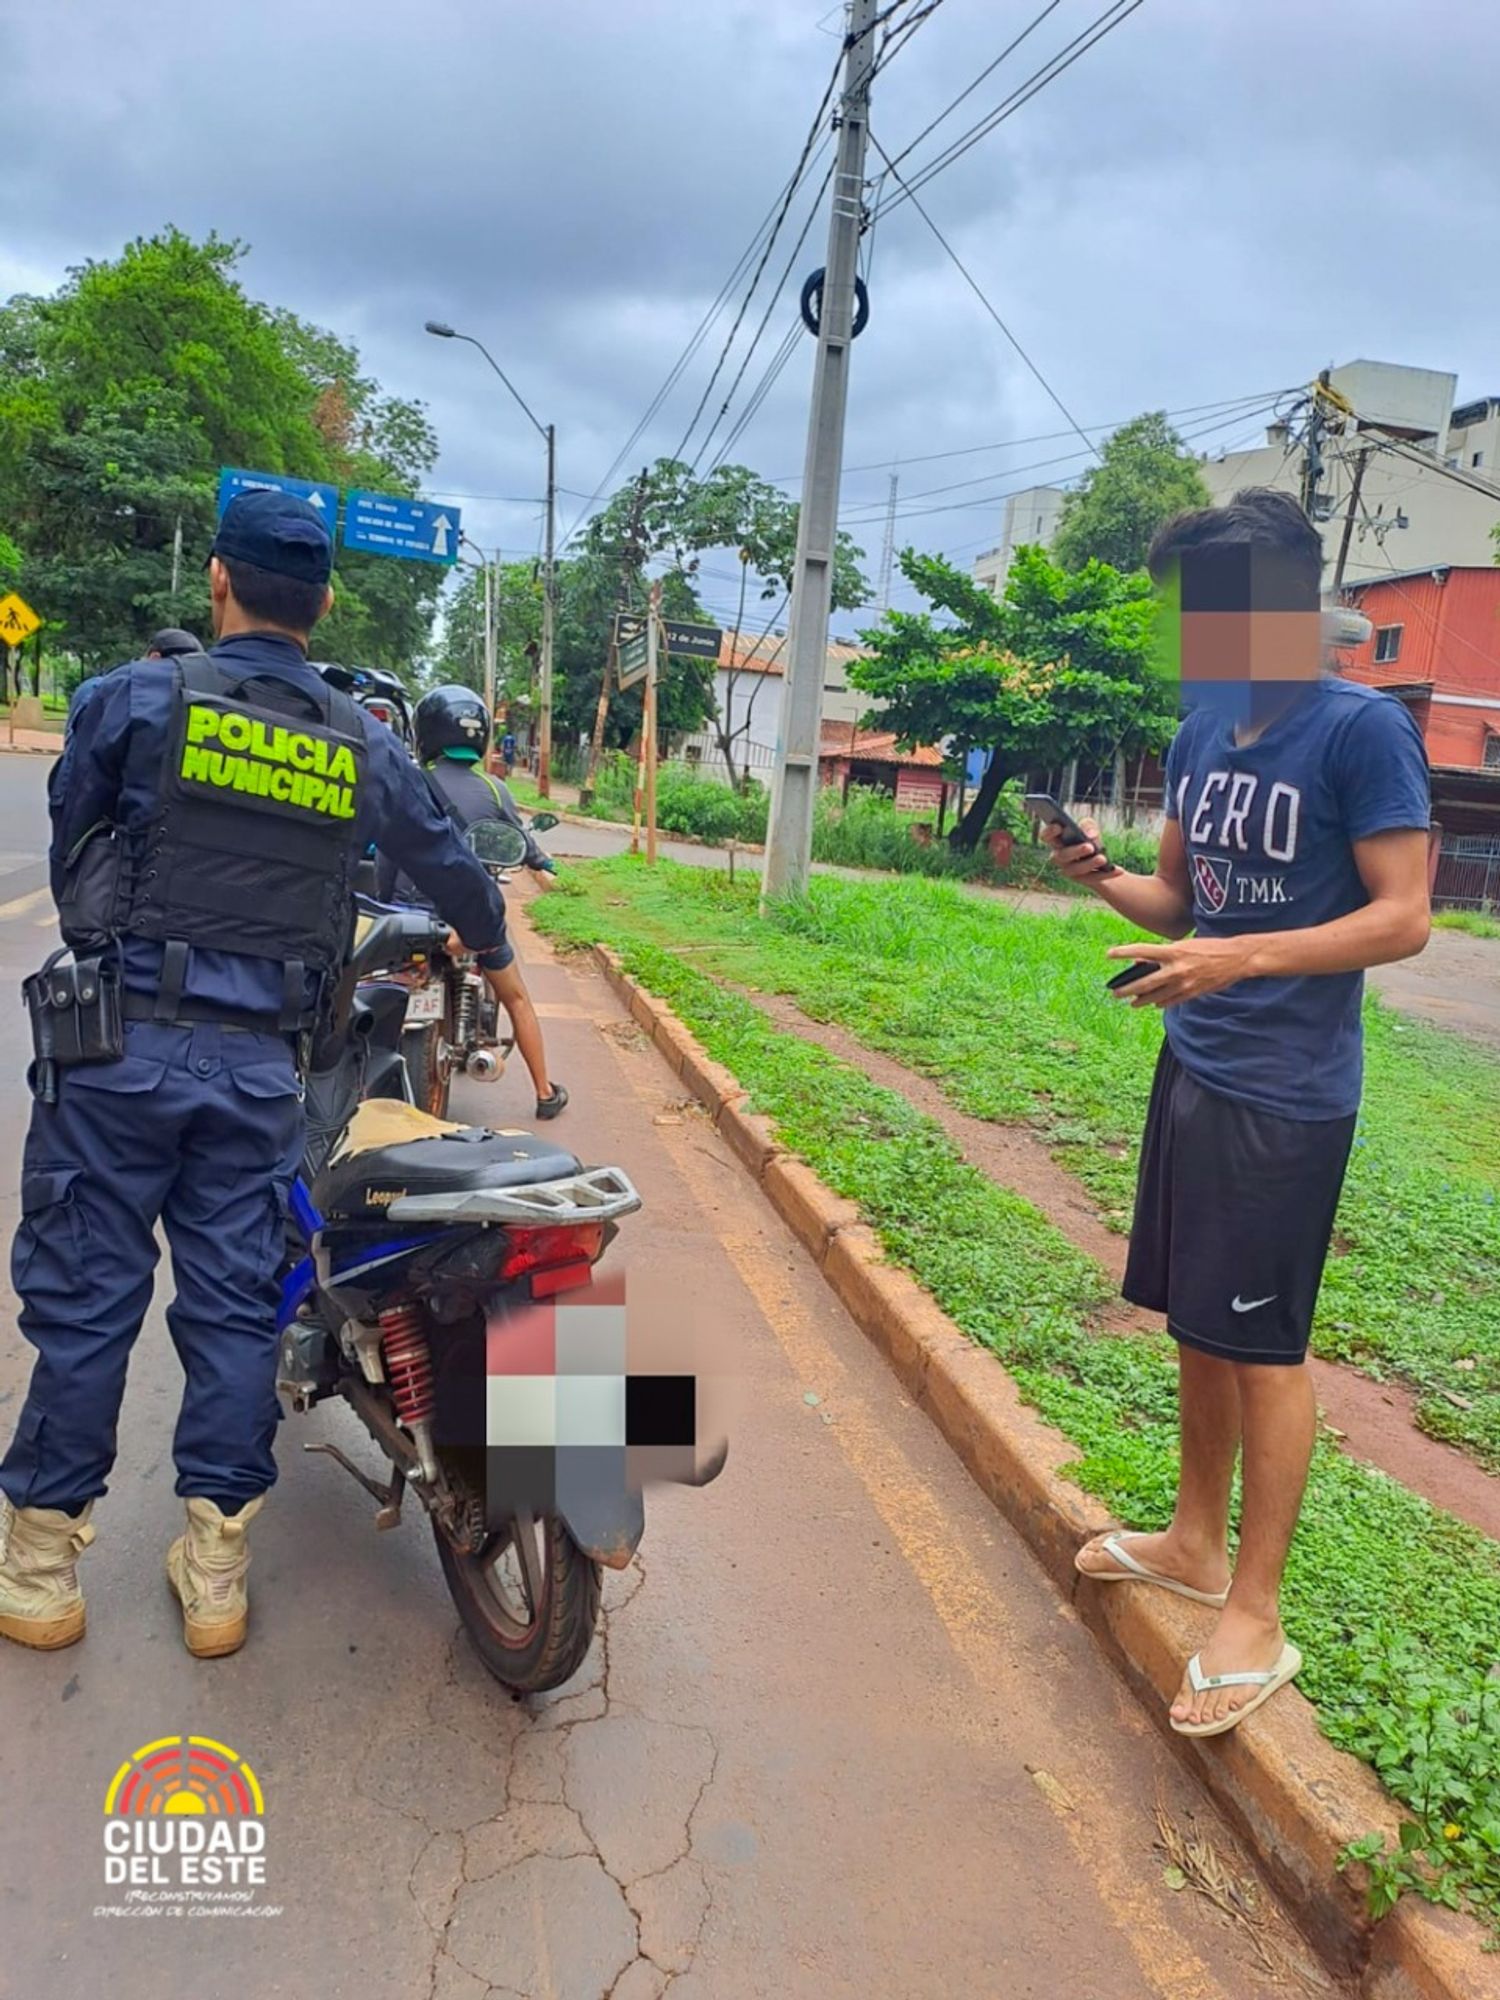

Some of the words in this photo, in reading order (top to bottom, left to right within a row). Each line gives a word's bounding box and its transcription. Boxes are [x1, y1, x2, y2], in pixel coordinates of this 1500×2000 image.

[181, 744, 356, 819] MUNICIPAL
[187, 704, 357, 785] POLICIA
[1236, 877, 1294, 903] TMK.
